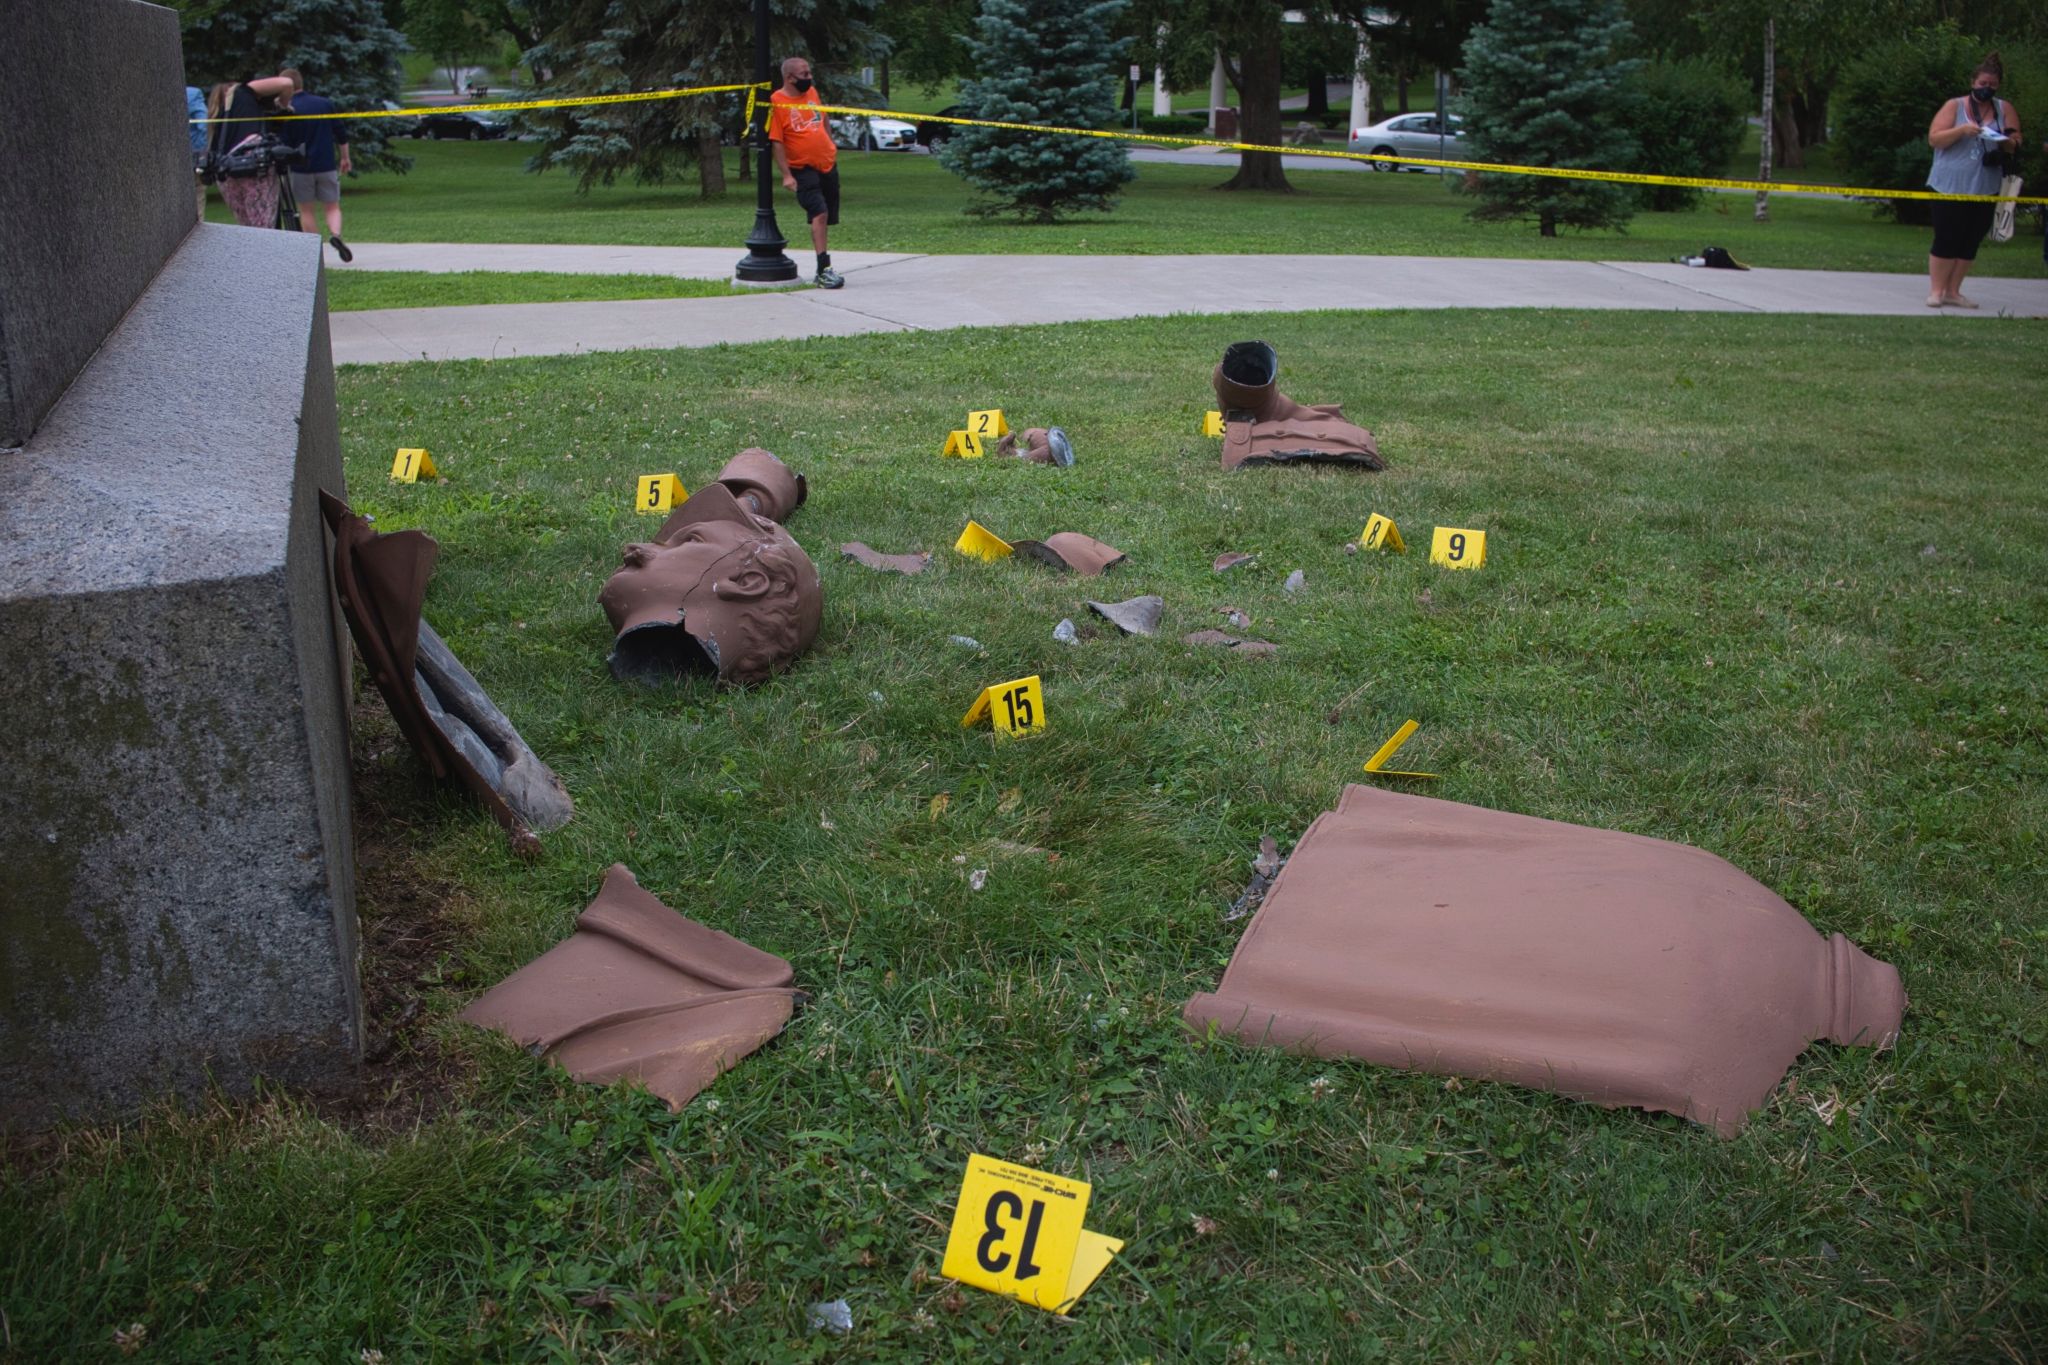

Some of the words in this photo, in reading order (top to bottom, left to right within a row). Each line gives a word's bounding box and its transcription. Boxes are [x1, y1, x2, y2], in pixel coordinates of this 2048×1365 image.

[978, 414, 990, 433] 2
[965, 433, 976, 454] 4
[403, 454, 412, 477] 1
[648, 480, 661, 507] 5
[1367, 520, 1381, 546] 8
[1448, 533, 1466, 562] 9
[1002, 686, 1034, 733] 15
[976, 1190, 1045, 1281] 13
